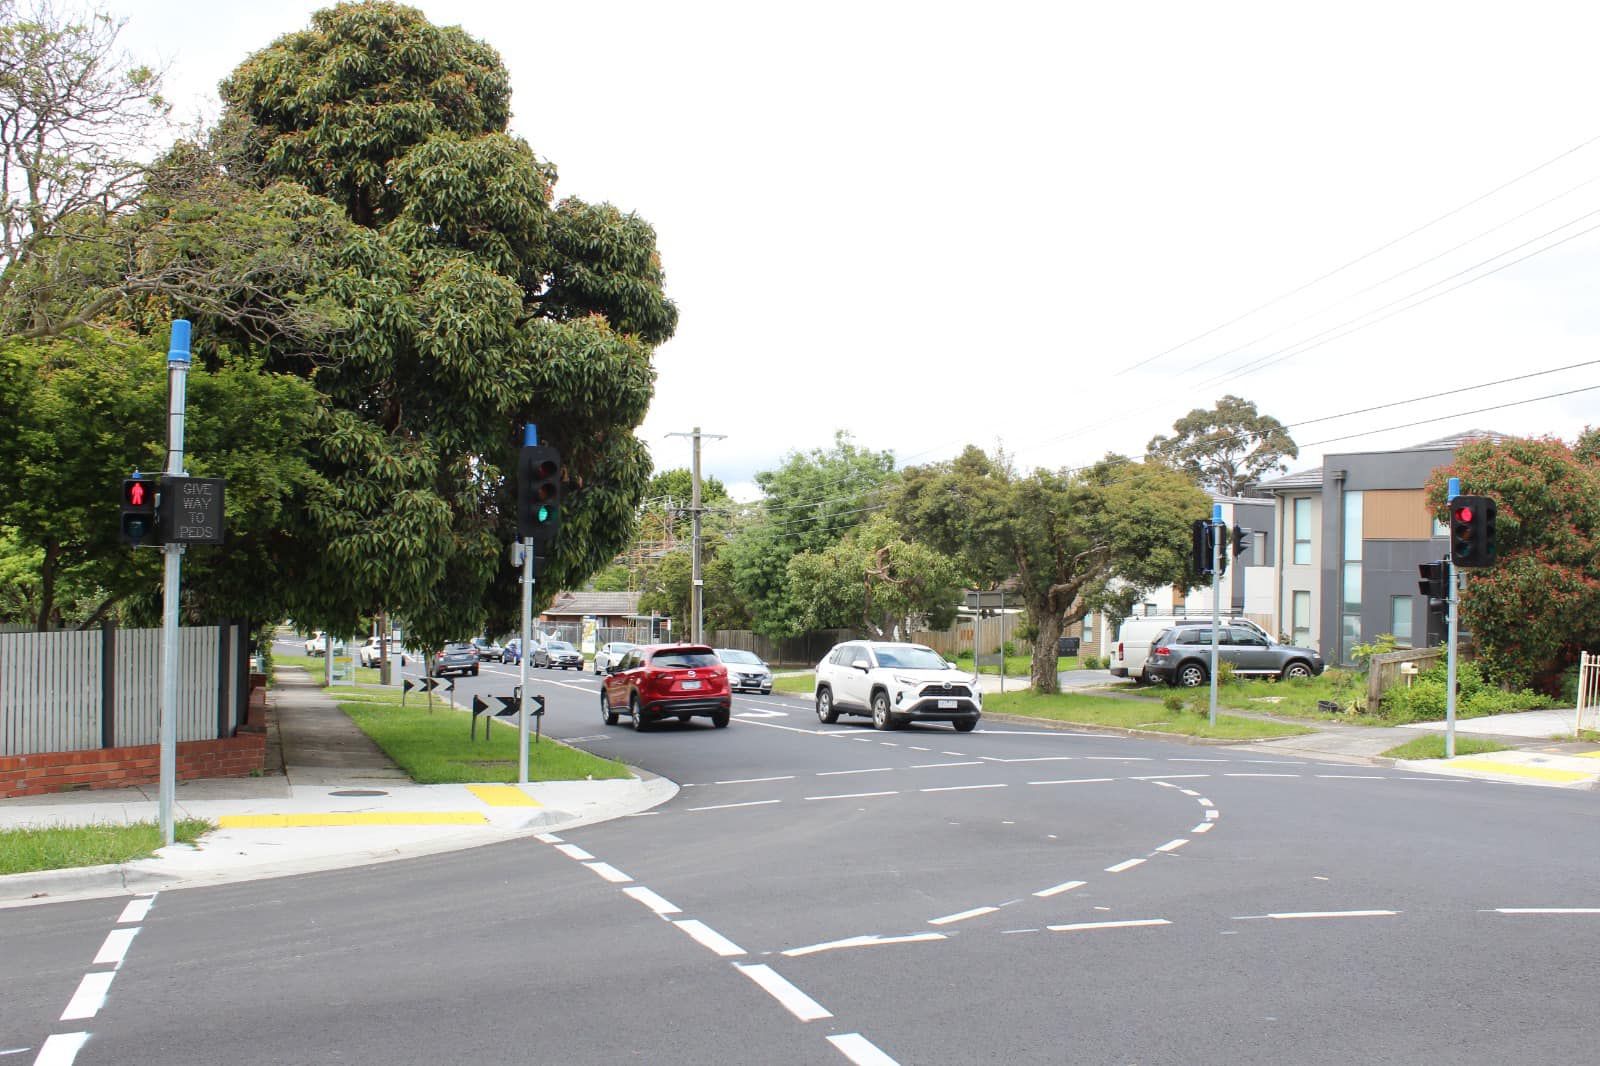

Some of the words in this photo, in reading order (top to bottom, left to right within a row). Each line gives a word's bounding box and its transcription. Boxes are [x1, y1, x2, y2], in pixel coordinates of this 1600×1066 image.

[183, 483, 213, 495] GIVE
[183, 497, 212, 509] WAY
[187, 511, 205, 523] TO
[179, 526, 213, 538] PEDS
